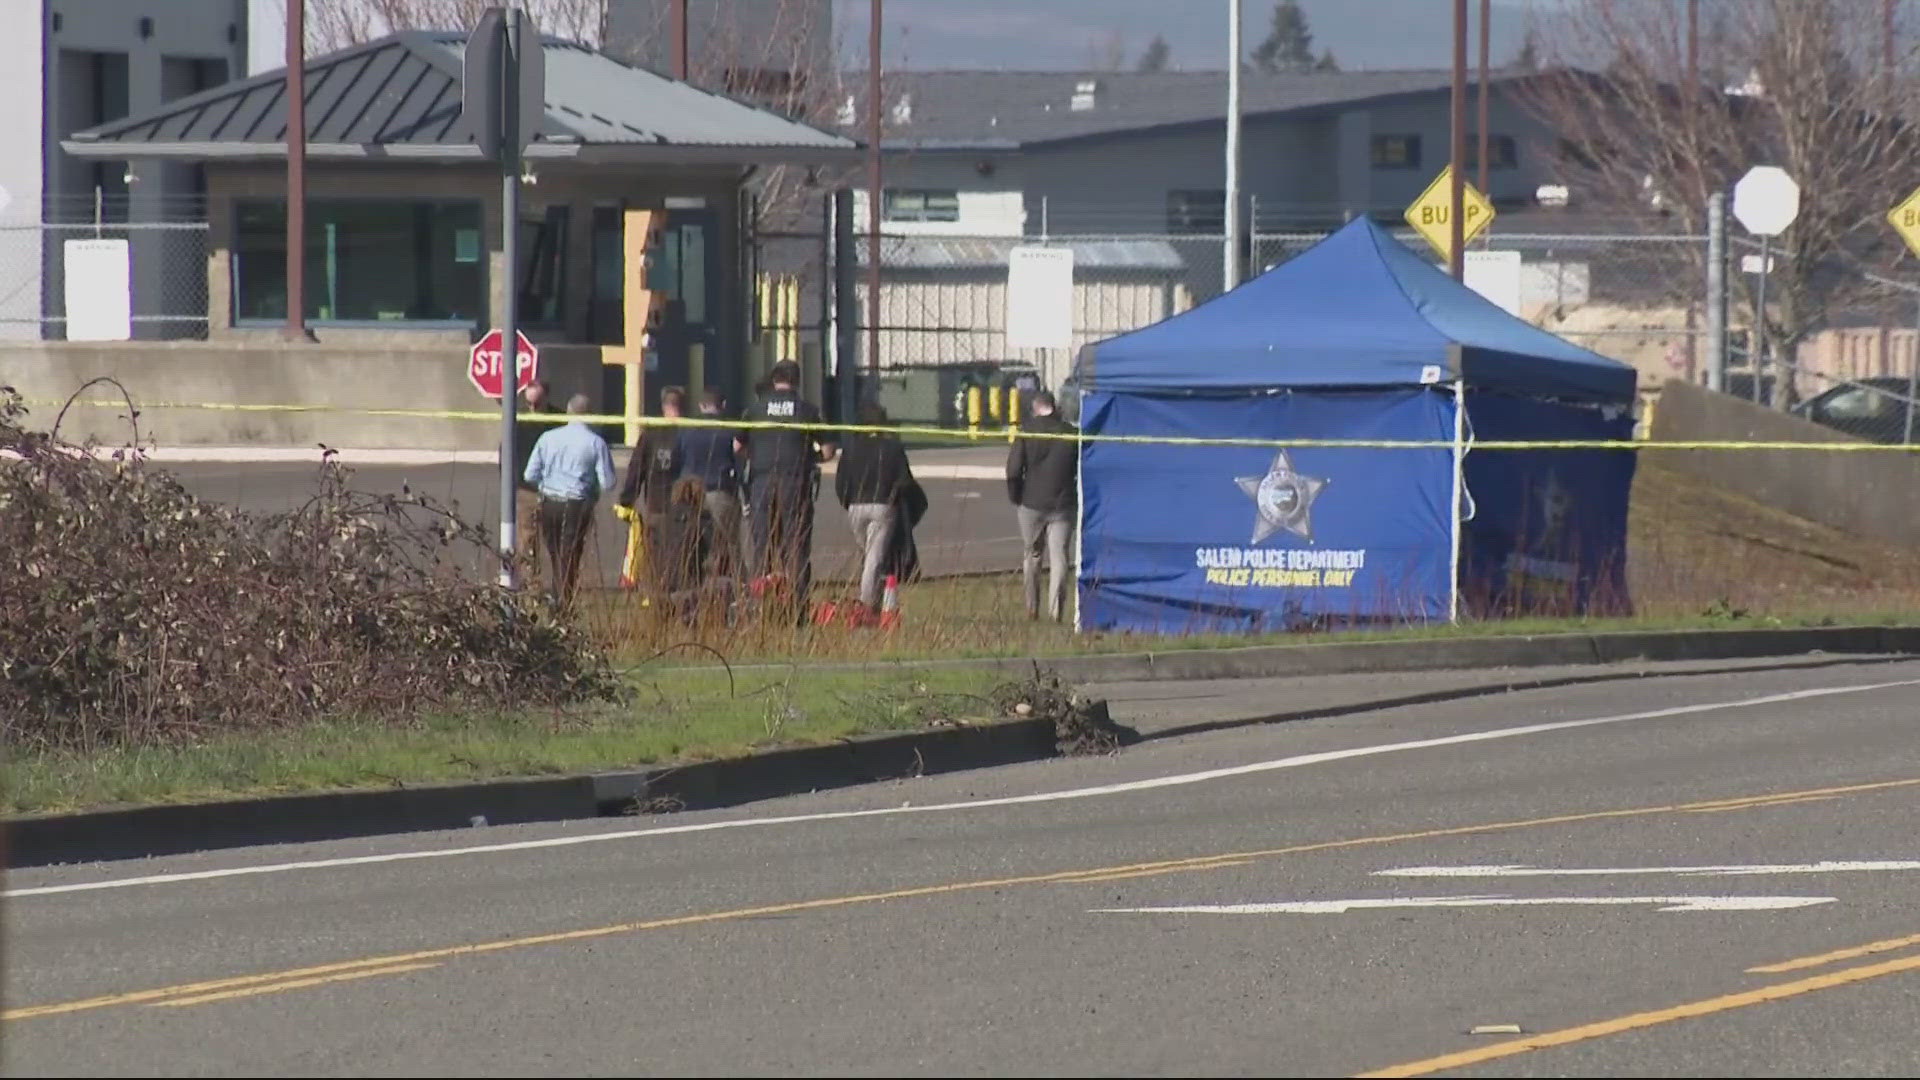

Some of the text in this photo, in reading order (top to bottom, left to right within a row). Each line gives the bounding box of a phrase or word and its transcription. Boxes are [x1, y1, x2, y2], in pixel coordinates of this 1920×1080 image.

[1422, 206, 1479, 224] BUP
[474, 350, 532, 379] STP
[1196, 547, 1366, 569] SALEM POLICE DEPARTMENT
[1206, 568, 1355, 587] POLICE PERSONNEL ONLY
